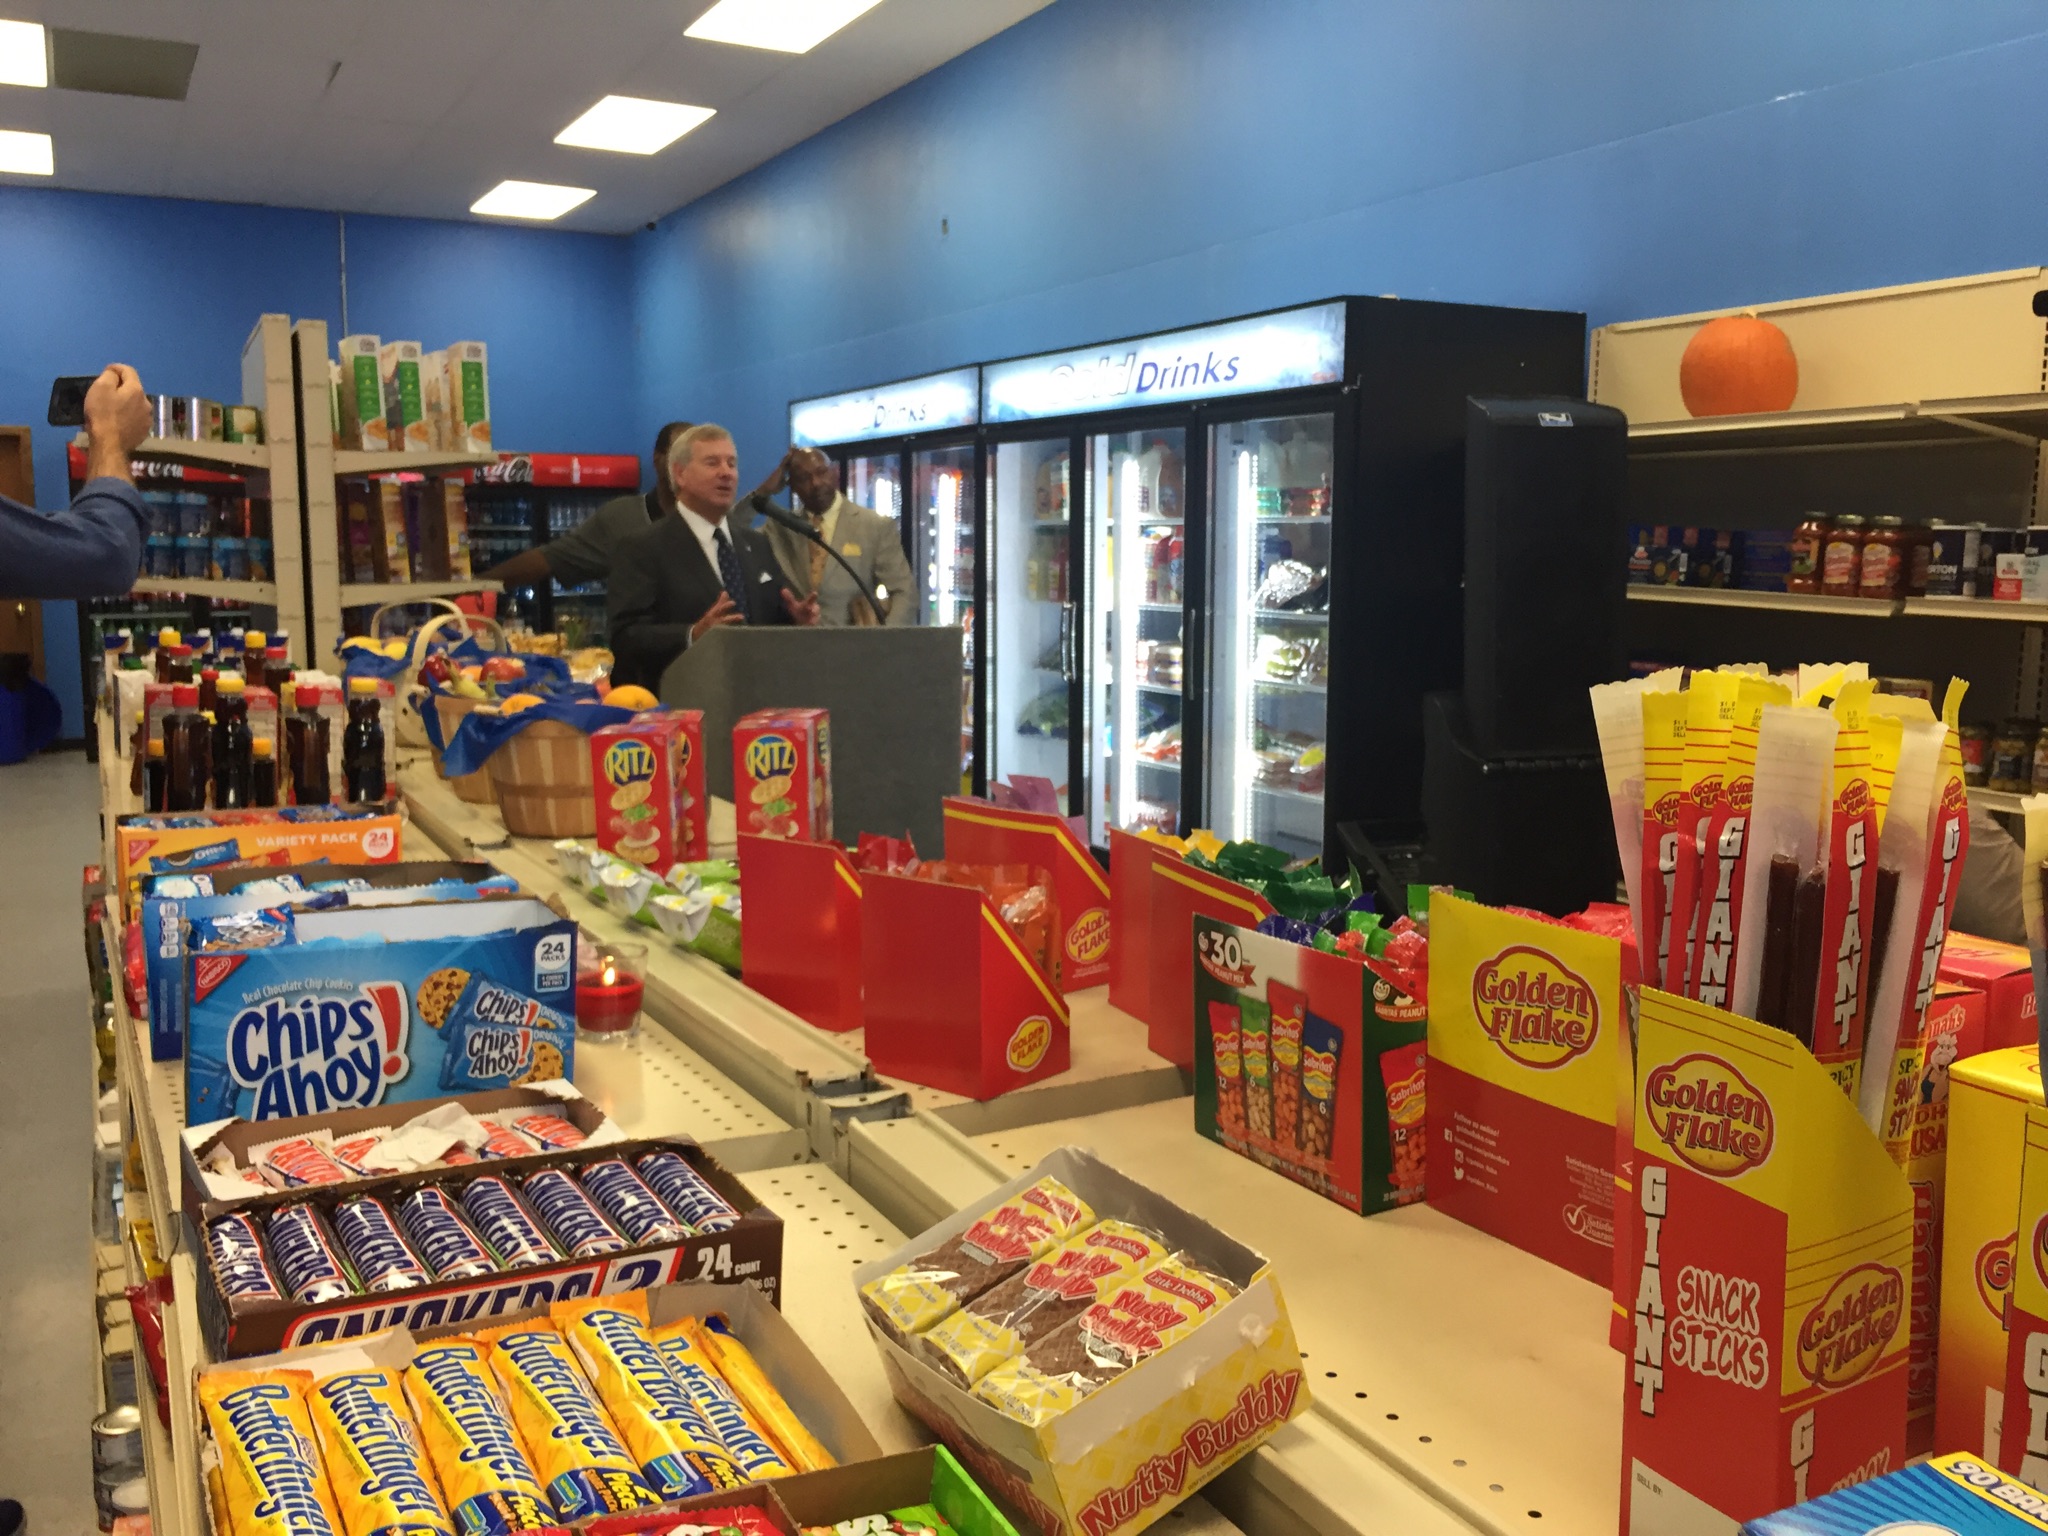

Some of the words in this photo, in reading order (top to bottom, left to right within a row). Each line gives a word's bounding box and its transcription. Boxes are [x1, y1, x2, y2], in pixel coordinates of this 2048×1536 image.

[1135, 351, 1240, 393] Drinks
[608, 746, 653, 784] RITZ
[750, 741, 793, 782] RITZ
[256, 834, 317, 847] VARIETY
[321, 832, 358, 843] PACK
[367, 831, 389, 842] 24
[541, 942, 565, 954] 24
[1210, 931, 1242, 971] 30
[1834, 820, 1867, 1048] GIANT
[201, 958, 229, 986] NABISCO
[541, 953, 565, 962] PACKS
[241, 986, 262, 1004] Real
[262, 979, 303, 996] Chocolate
[304, 977, 323, 991] Chip
[1478, 967, 1589, 1018] Golden
[1272, 1024, 1299, 1040] Sabritas
[1399, 1006, 1427, 1018] PEANUT
[1488, 1006, 1586, 1048] Flake
[1218, 1076, 1227, 1088] 12
[1249, 1076, 1256, 1088] 6
[1272, 1060, 1280, 1073] 6
[1303, 1053, 1333, 1072] Sabritas
[1319, 1101, 1327, 1114] 6
[1389, 1076, 1426, 1105] Sabritas
[1652, 1071, 1766, 1131] Golden
[1394, 1128, 1407, 1142] 12
[1662, 1111, 1761, 1159] Flake
[523, 1170, 617, 1251] SNICKERS
[963, 1221, 1032, 1263] Buddy
[697, 1243, 733, 1282] 24
[735, 1260, 761, 1276] COUNT
[1024, 1262, 1098, 1301] Buddy
[1054, 1250, 1123, 1278] Nutty
[1149, 1271, 1175, 1291] Little
[1173, 1281, 1209, 1305] Debbie
[1634, 1166, 1668, 1418] GIANT
[1677, 1266, 1760, 1336] SNACK
[1079, 1303, 1163, 1358] Buddy
[1110, 1289, 1188, 1332] Nutty
[1802, 1277, 1898, 1351] Golden
[1670, 1316, 1769, 1390] STICKS
[1812, 1310, 1895, 1386] Flake
[497, 1332, 636, 1466] Butterfinger
[582, 1309, 730, 1452] Butterfinger
[411, 1347, 541, 1493] Butterfinger
[318, 1373, 445, 1521] Butterfinger
[1077, 1446, 1188, 1536] Nutty
[1183, 1369, 1301, 1467] Buddy
[603, 1472, 639, 1511] Piece
